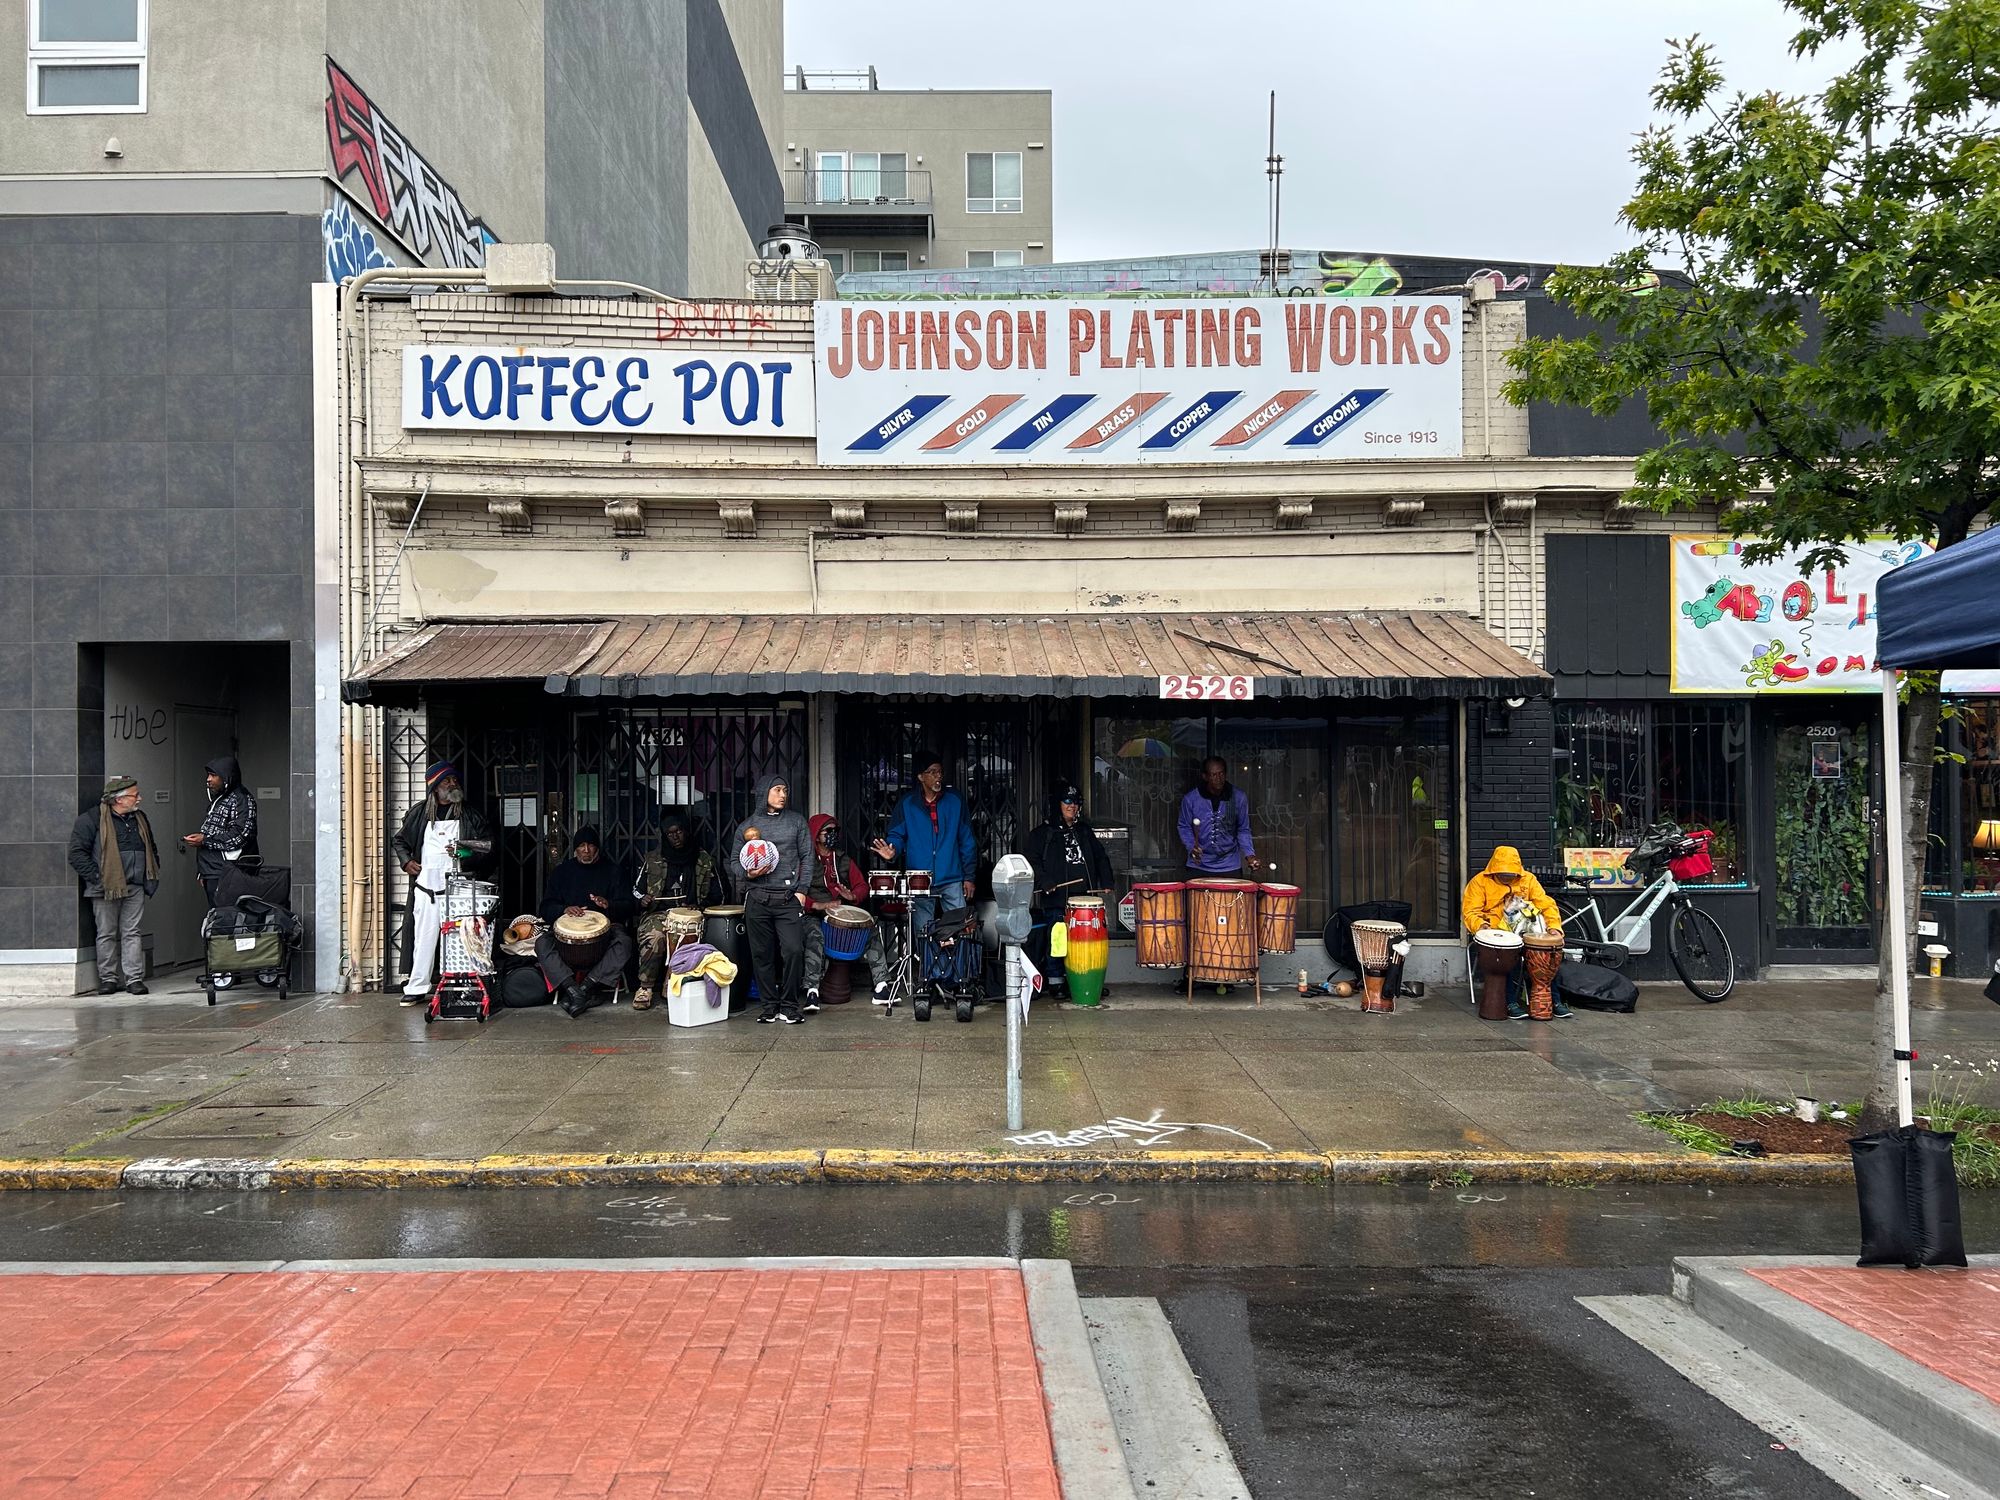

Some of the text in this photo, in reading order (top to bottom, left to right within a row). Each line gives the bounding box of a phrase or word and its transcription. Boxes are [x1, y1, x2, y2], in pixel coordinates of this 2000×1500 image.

[827, 303, 1451, 378] JOHNSON PLATING WORKS
[419, 354, 792, 428] KOFFEE POT
[878, 395, 1361, 440] SILVER GOLD TIN BRASS COPPER NICKEL CHROME
[1364, 431, 1438, 444] Since 1913
[1164, 675, 1248, 699] 2526
[110, 704, 168, 745] tube
[1806, 726, 1837, 737] 2520
